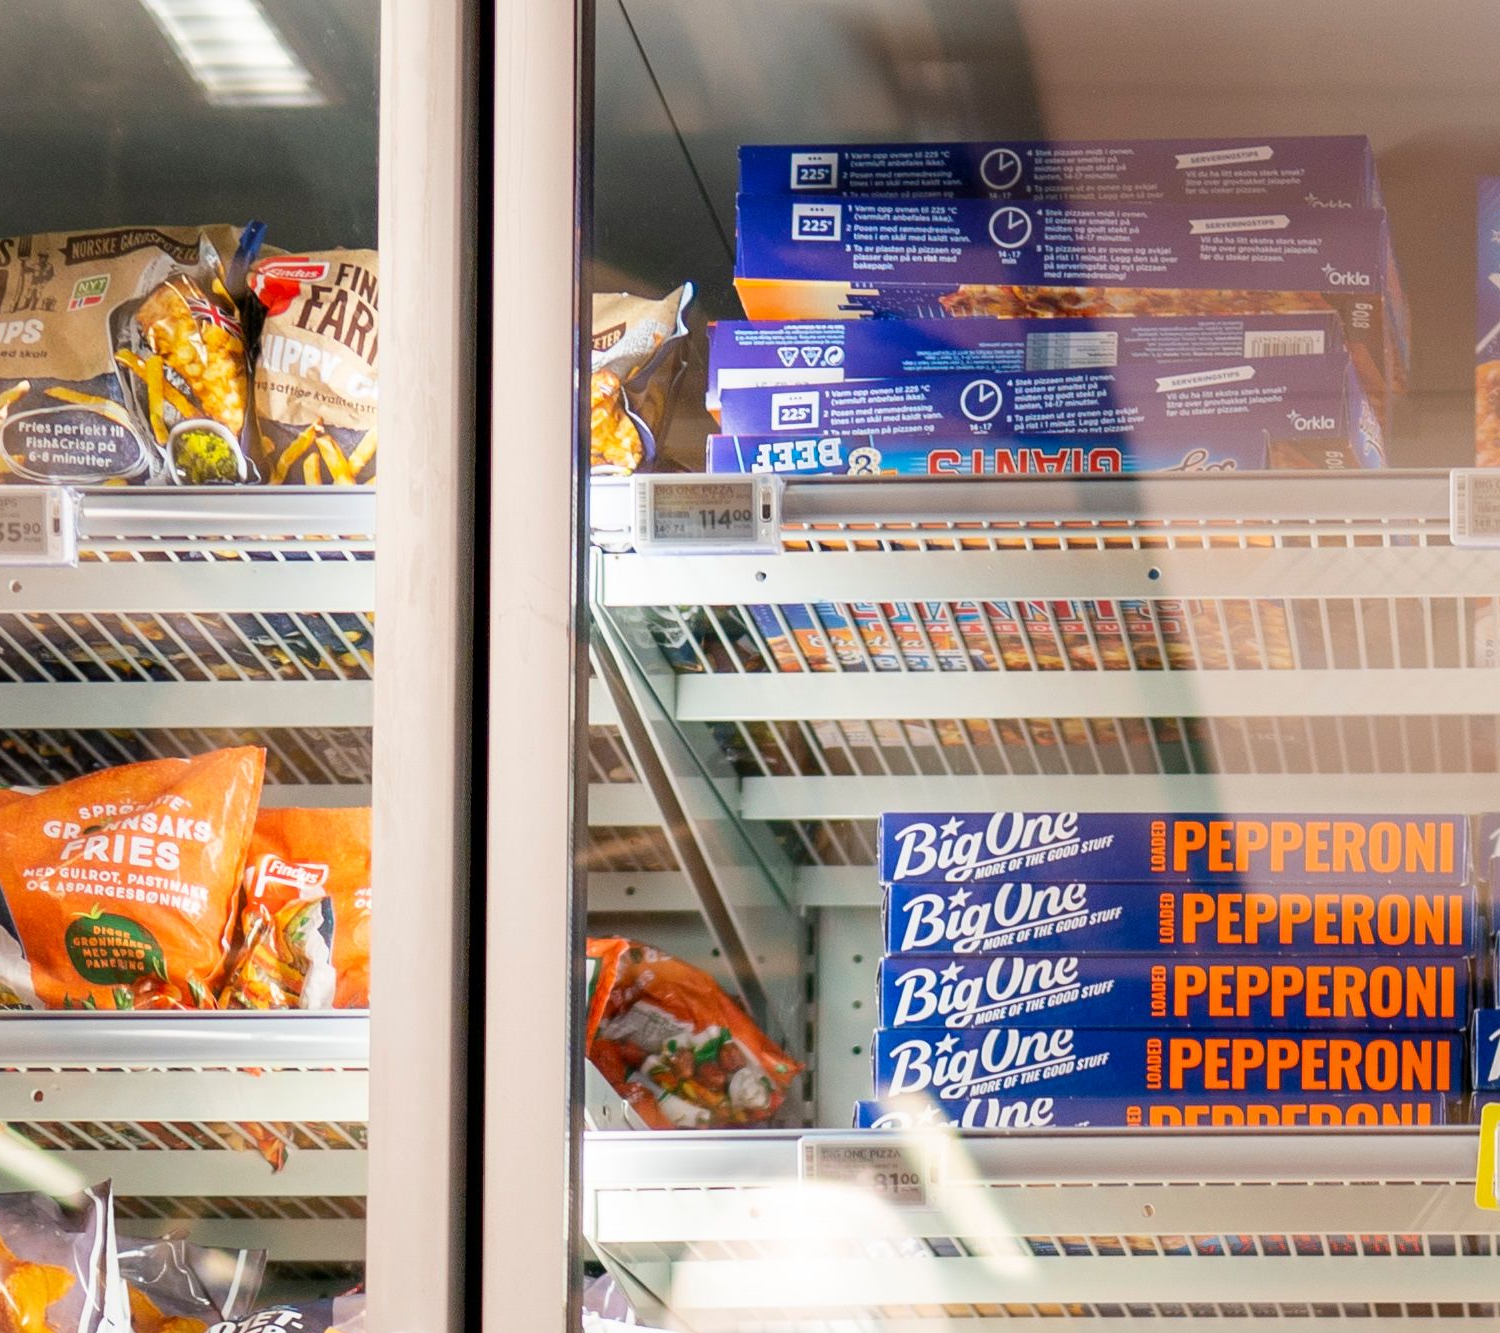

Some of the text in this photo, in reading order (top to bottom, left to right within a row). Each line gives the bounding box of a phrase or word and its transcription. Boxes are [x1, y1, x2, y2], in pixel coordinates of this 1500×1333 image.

[1205, 218, 1275, 229] SERVERINGSTIPS
[72, 236, 117, 256] NORSKE
[1331, 271, 1370, 285] Orkla
[19, 422, 124, 438] Fries perfekt til
[26, 437, 116, 453] Fish&Crisp på
[29, 452, 111, 467] 6-8 minutter
[60, 834, 180, 870] FRIES
[1151, 821, 1455, 873] LOADED PEPPERONI
[23, 867, 122, 885] MED GULROT,
[894, 958, 1079, 1028] Big One
[975, 980, 1114, 1025] MORE OF THE GOOD STUFF
